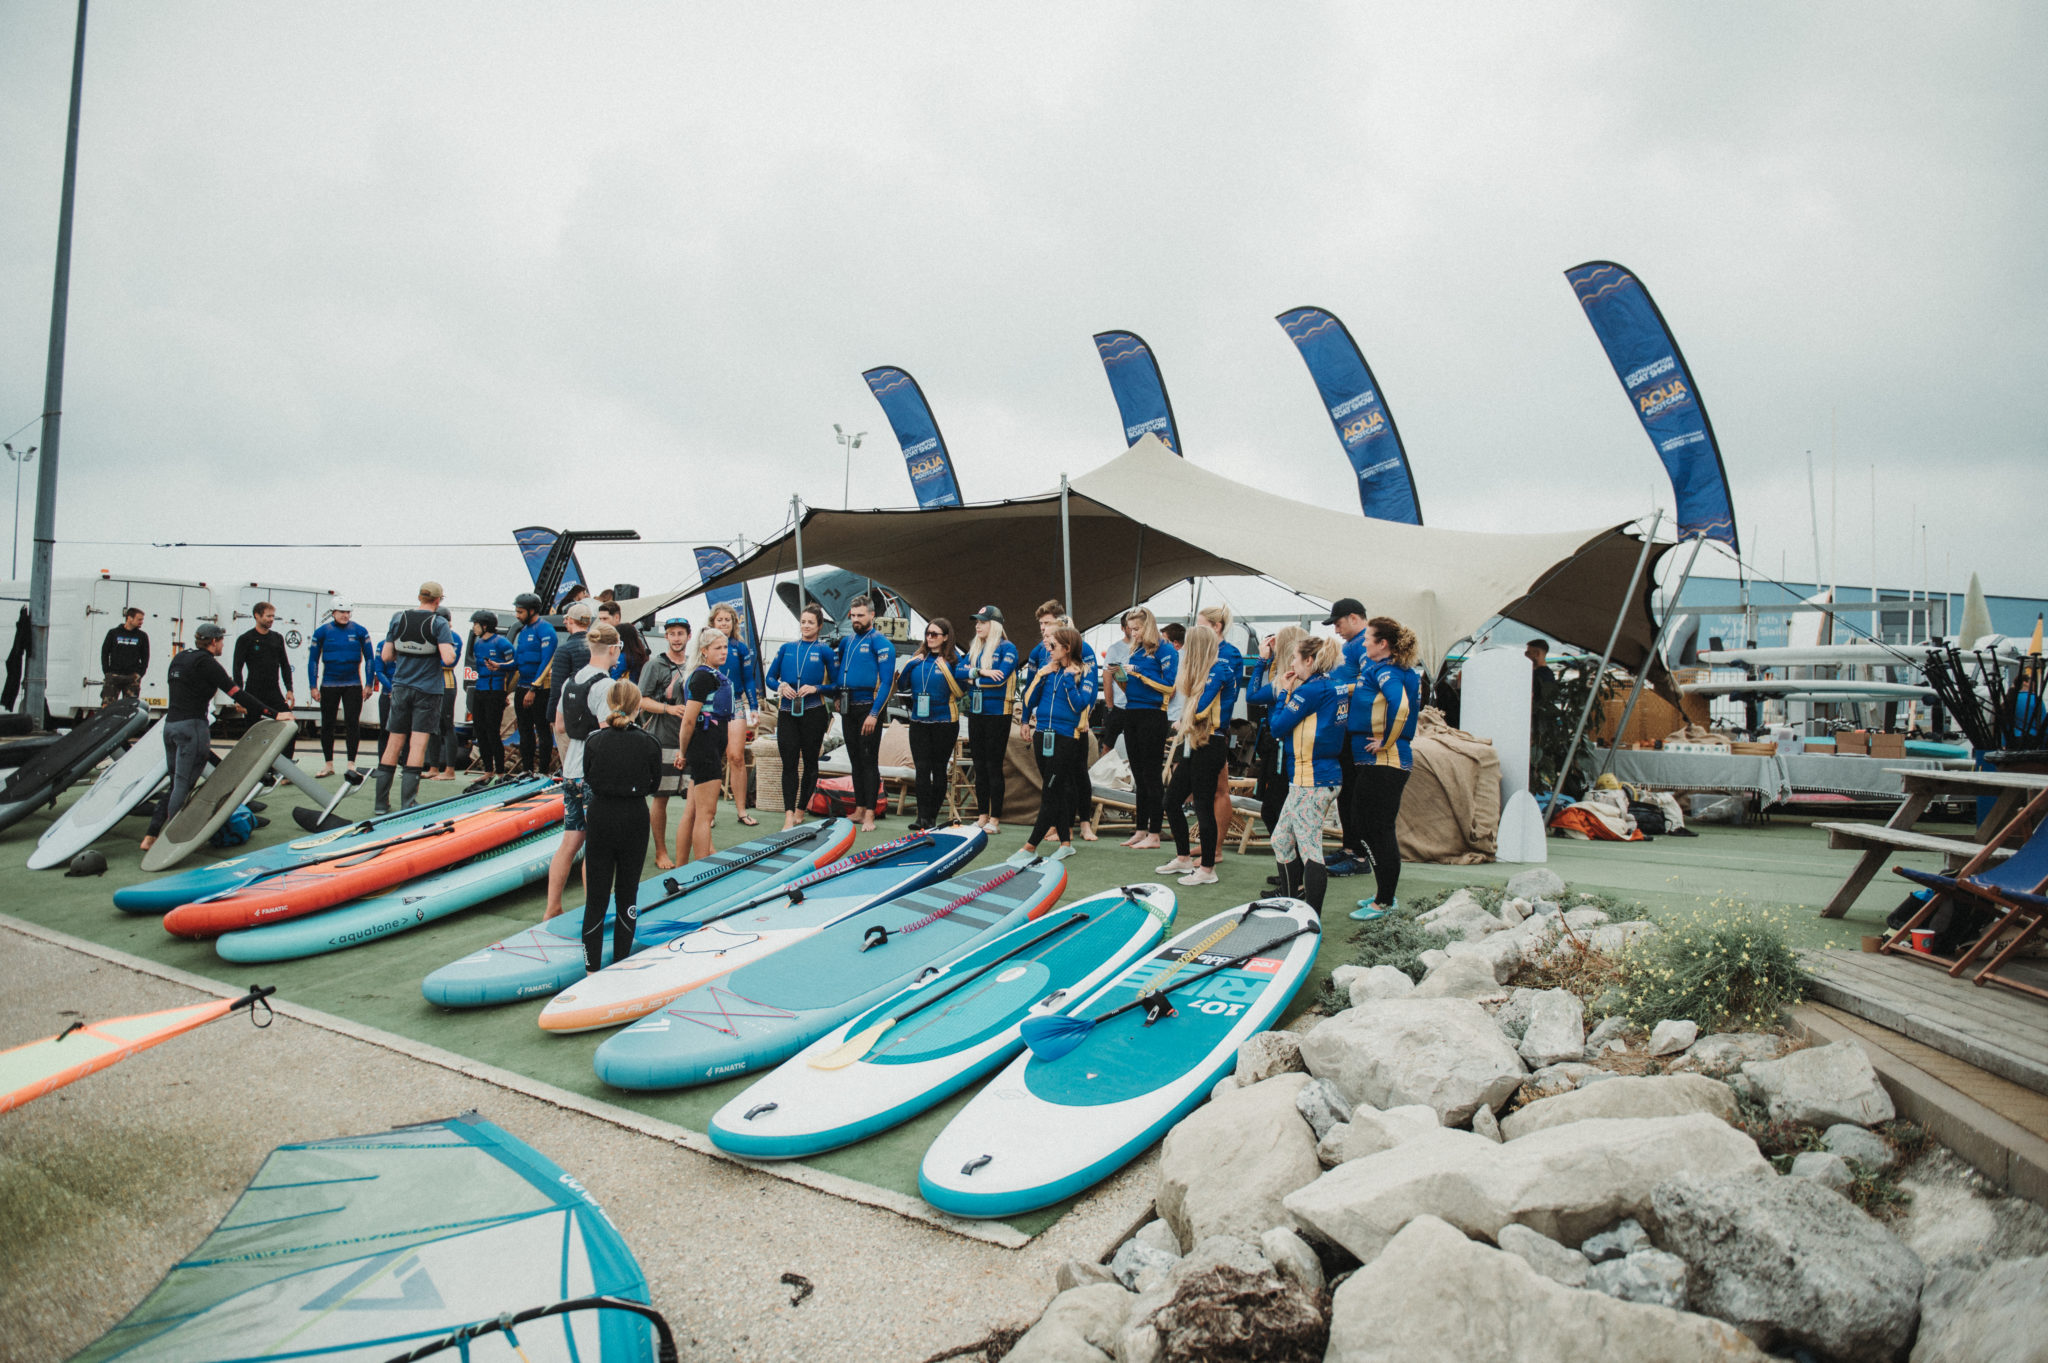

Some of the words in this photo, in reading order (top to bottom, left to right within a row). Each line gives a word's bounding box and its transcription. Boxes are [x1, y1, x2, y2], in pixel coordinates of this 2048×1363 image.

[1627, 371, 1648, 389] BOAT
[1650, 360, 1675, 378] SHOW
[1333, 404, 1351, 419] BOAT
[1351, 393, 1374, 411] SHOW
[1640, 380, 1687, 412] AQUA
[1646, 392, 1686, 415] BOOTCAMP
[1127, 427, 1145, 439] BOAT
[1146, 421, 1167, 432] SHOW
[1344, 412, 1384, 441] AQUA
[1348, 423, 1383, 443] BOOTCAMP
[919, 440, 937, 453] SHOW
[911, 455, 944, 477] AQUA
[464, 667, 479, 680] Re
[1336, 703, 1348, 716] AQU
[261, 904, 288, 915] FANATIC
[524, 982, 553, 993] FANATIC
[1112, 962, 1272, 1004] RIDE
[714, 1062, 746, 1075] FANATIC
